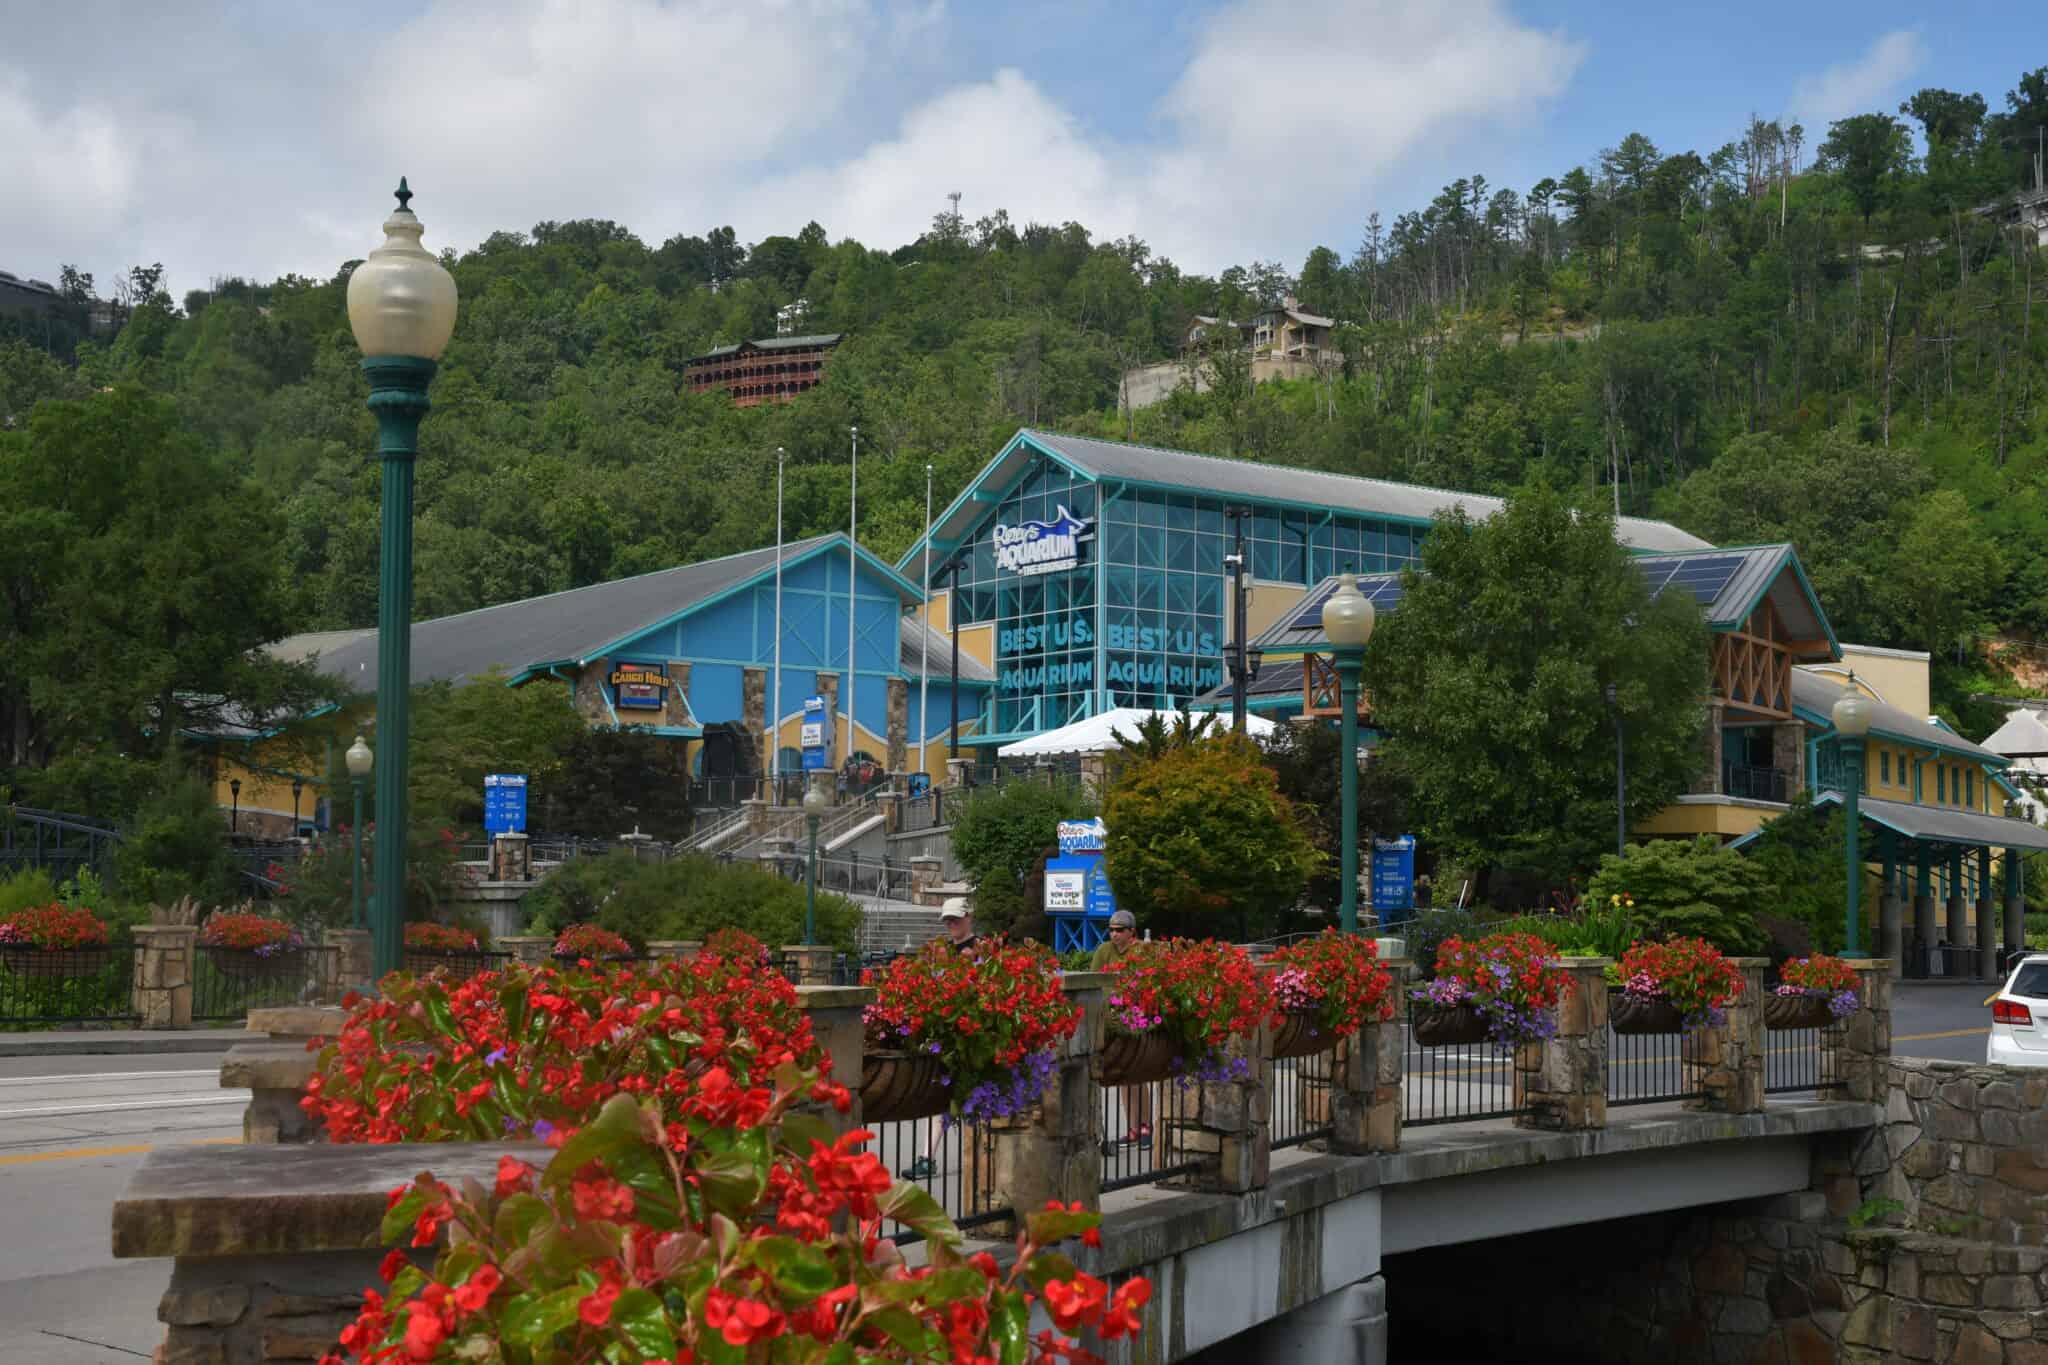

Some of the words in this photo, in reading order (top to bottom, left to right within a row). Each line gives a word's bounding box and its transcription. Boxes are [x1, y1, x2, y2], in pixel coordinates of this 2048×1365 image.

[996, 534, 1077, 571] AQUARIUM
[1000, 624, 1051, 653] BEST
[1055, 619, 1093, 645] US.
[1108, 624, 1171, 650] BEST
[1002, 661, 1093, 689] AQUARIUM
[1108, 661, 1221, 688] AQUARIUM
[1059, 833, 1105, 854] AQUARIUM
